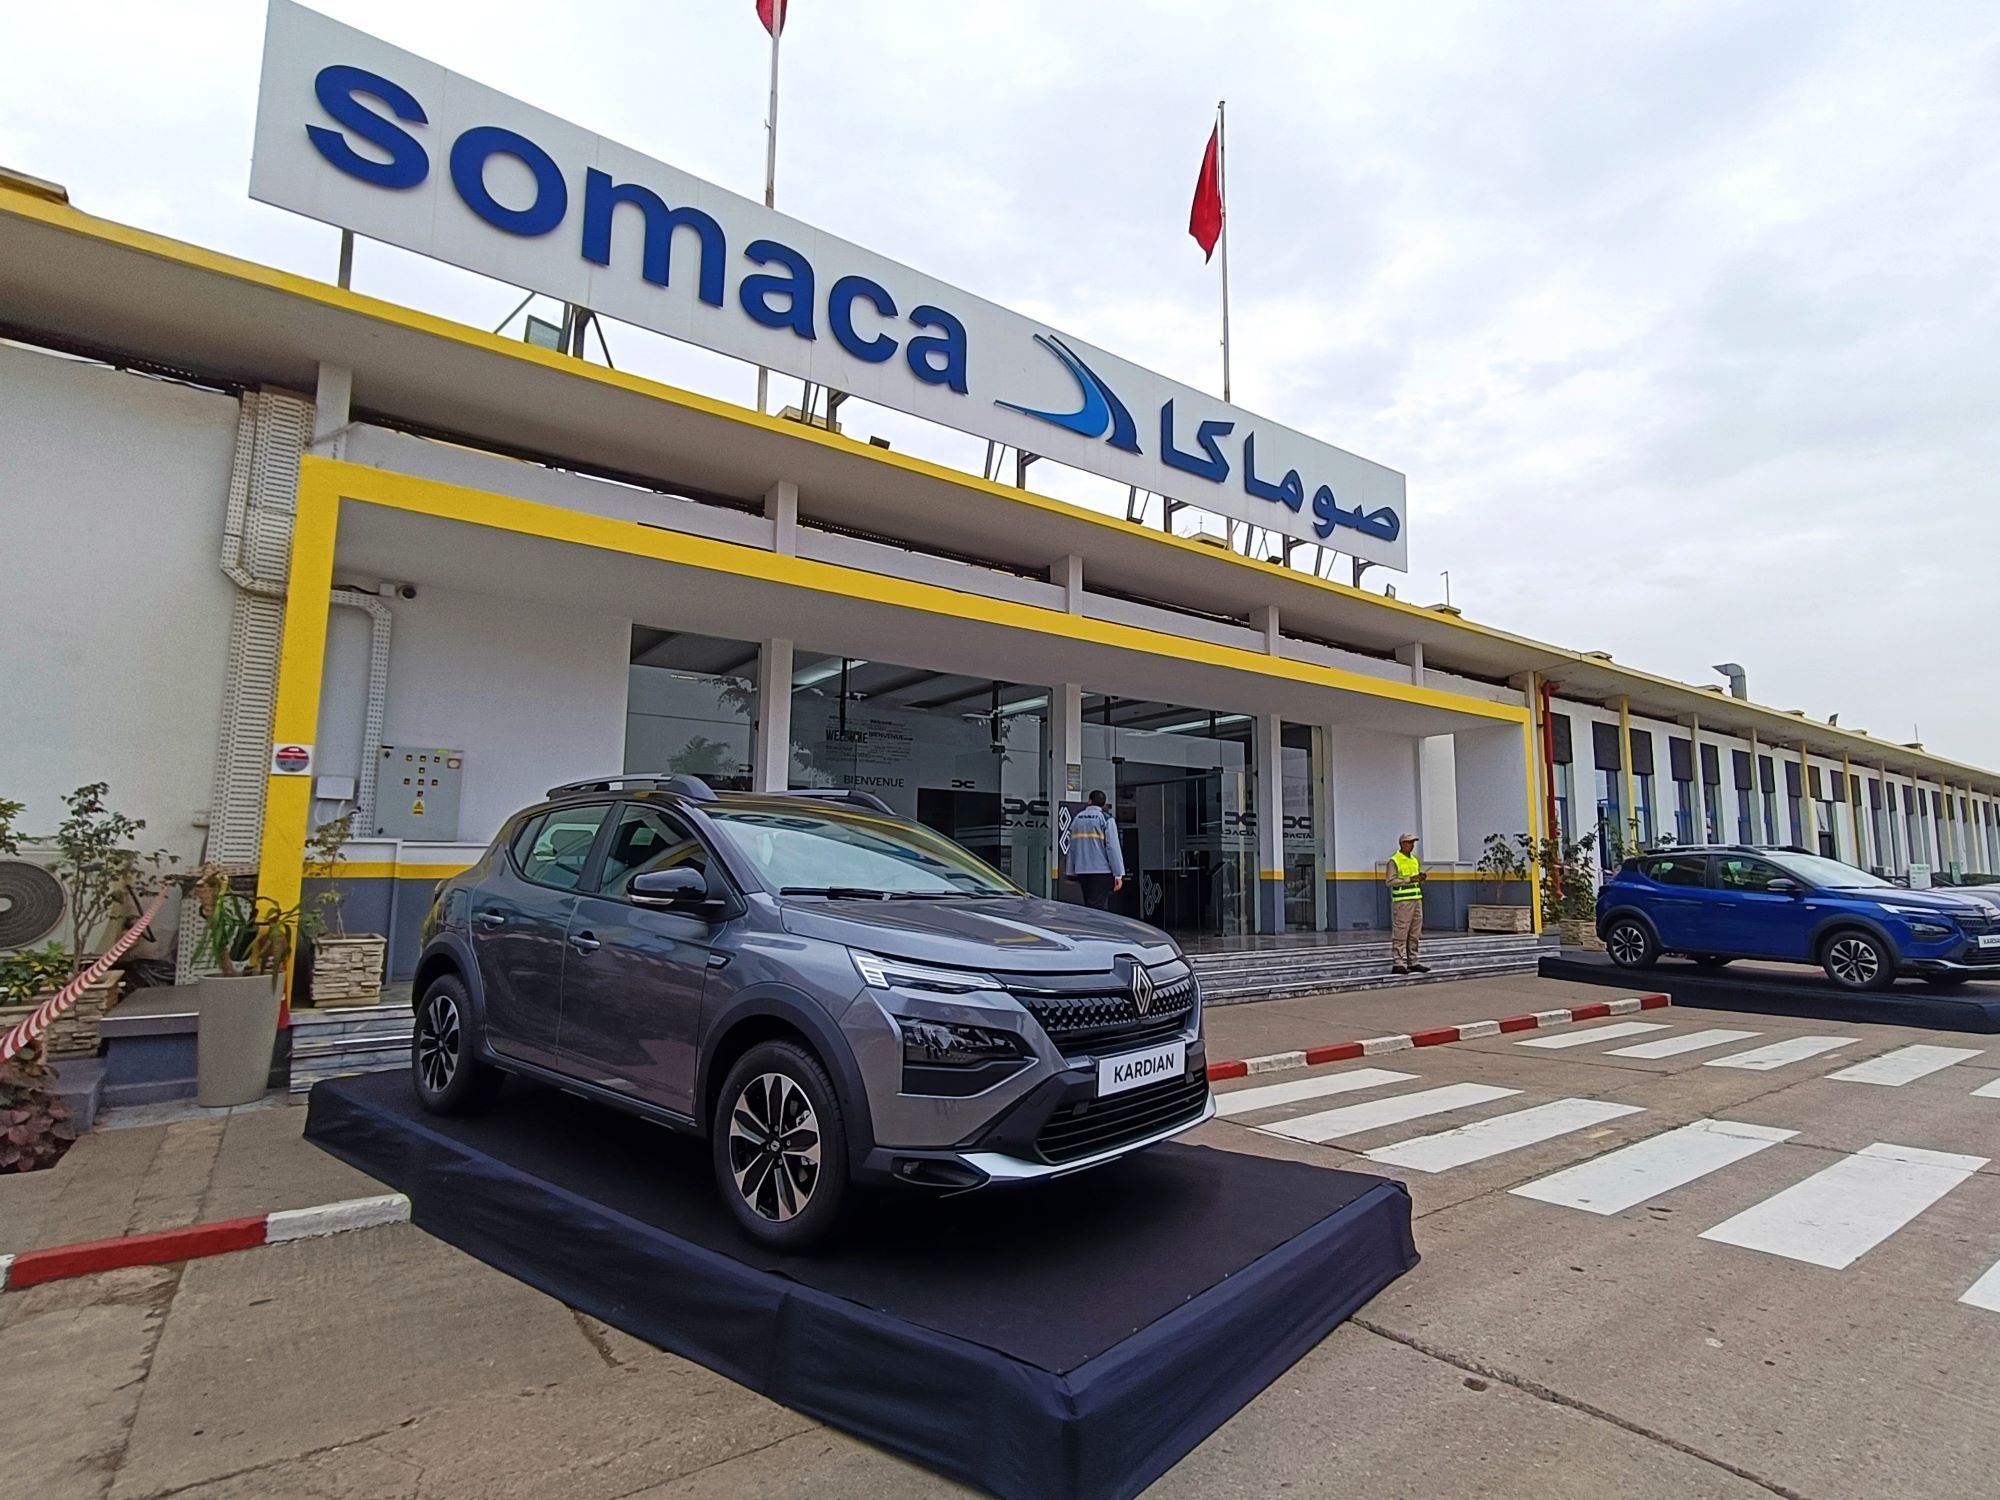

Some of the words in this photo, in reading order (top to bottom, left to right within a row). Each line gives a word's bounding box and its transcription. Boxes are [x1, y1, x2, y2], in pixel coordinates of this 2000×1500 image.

[305, 64, 968, 395] somaca
[1160, 397, 1401, 542] صوماكا
[843, 774, 905, 788] BIENVENUE
[1002, 819, 1049, 829] DACIA
[1223, 829, 1257, 837] DACIA
[1113, 1052, 1175, 1083] KARDIAN
